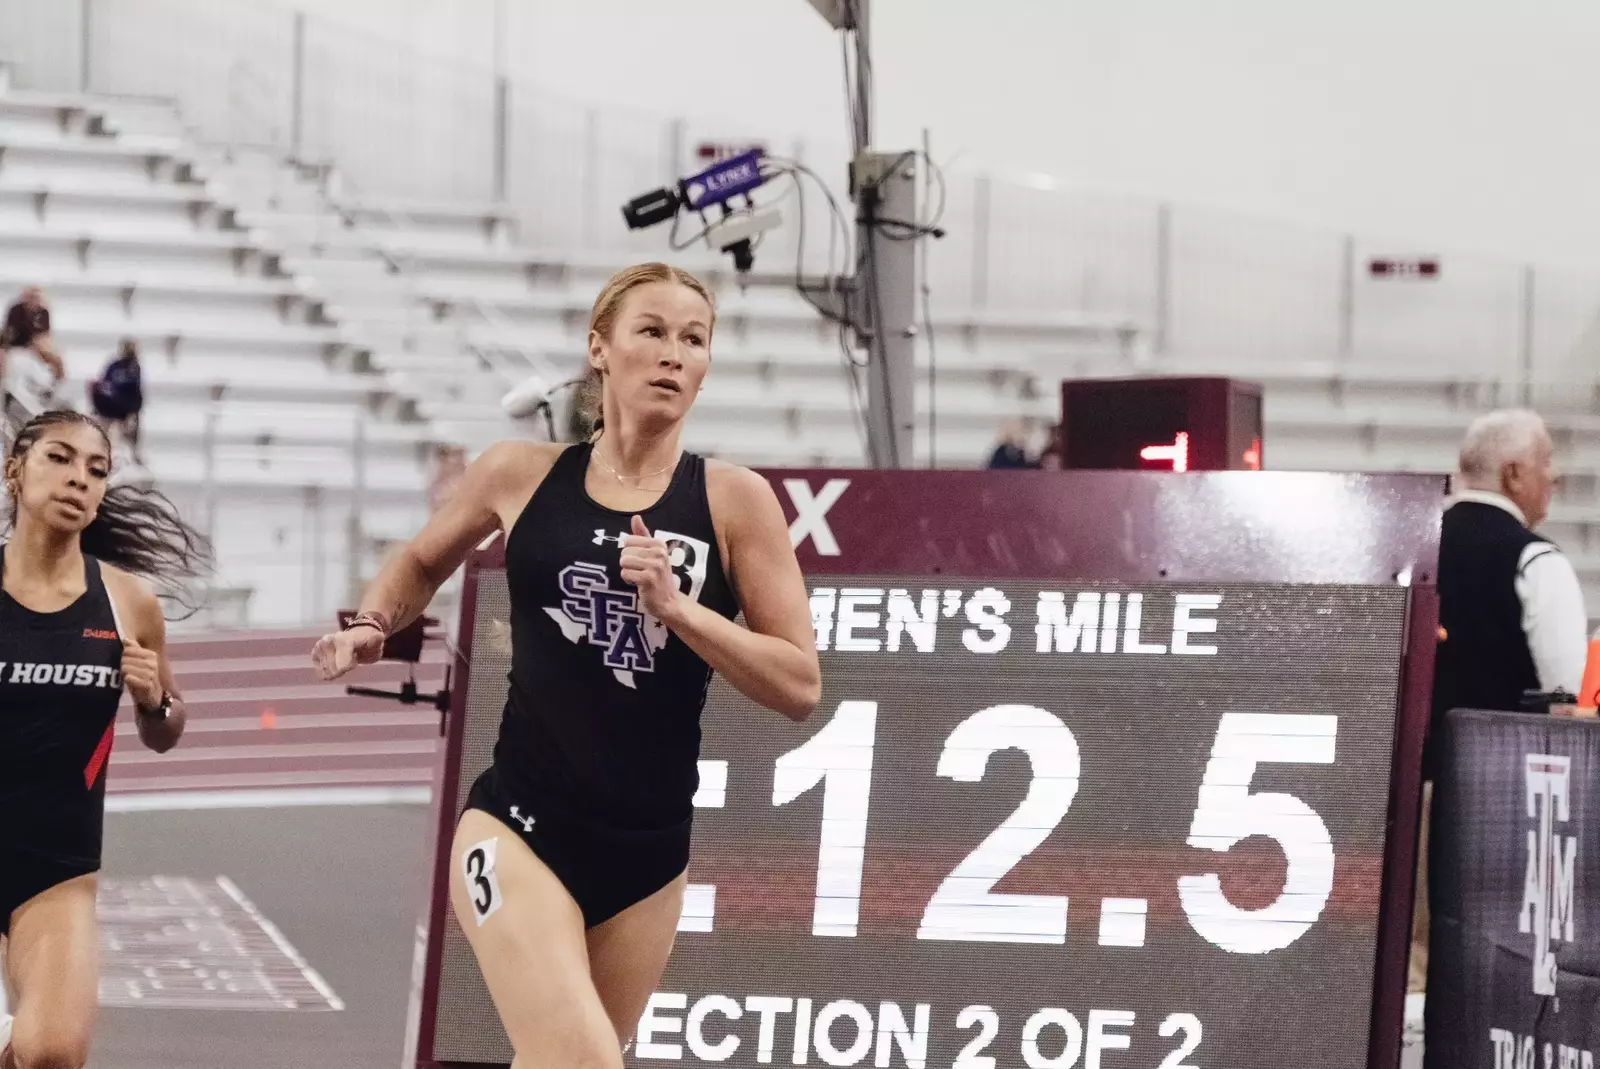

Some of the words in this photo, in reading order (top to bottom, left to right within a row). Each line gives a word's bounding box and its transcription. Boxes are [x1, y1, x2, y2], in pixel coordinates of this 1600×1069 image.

[558, 561, 655, 673] SFA
[1035, 591, 1224, 655] MILE
[467, 848, 492, 916] 3
[622, 992, 931, 1068] ECTION
[952, 1004, 1000, 1069] 2
[1021, 1007, 1136, 1069] OF
[1158, 1012, 1203, 1069] 2
